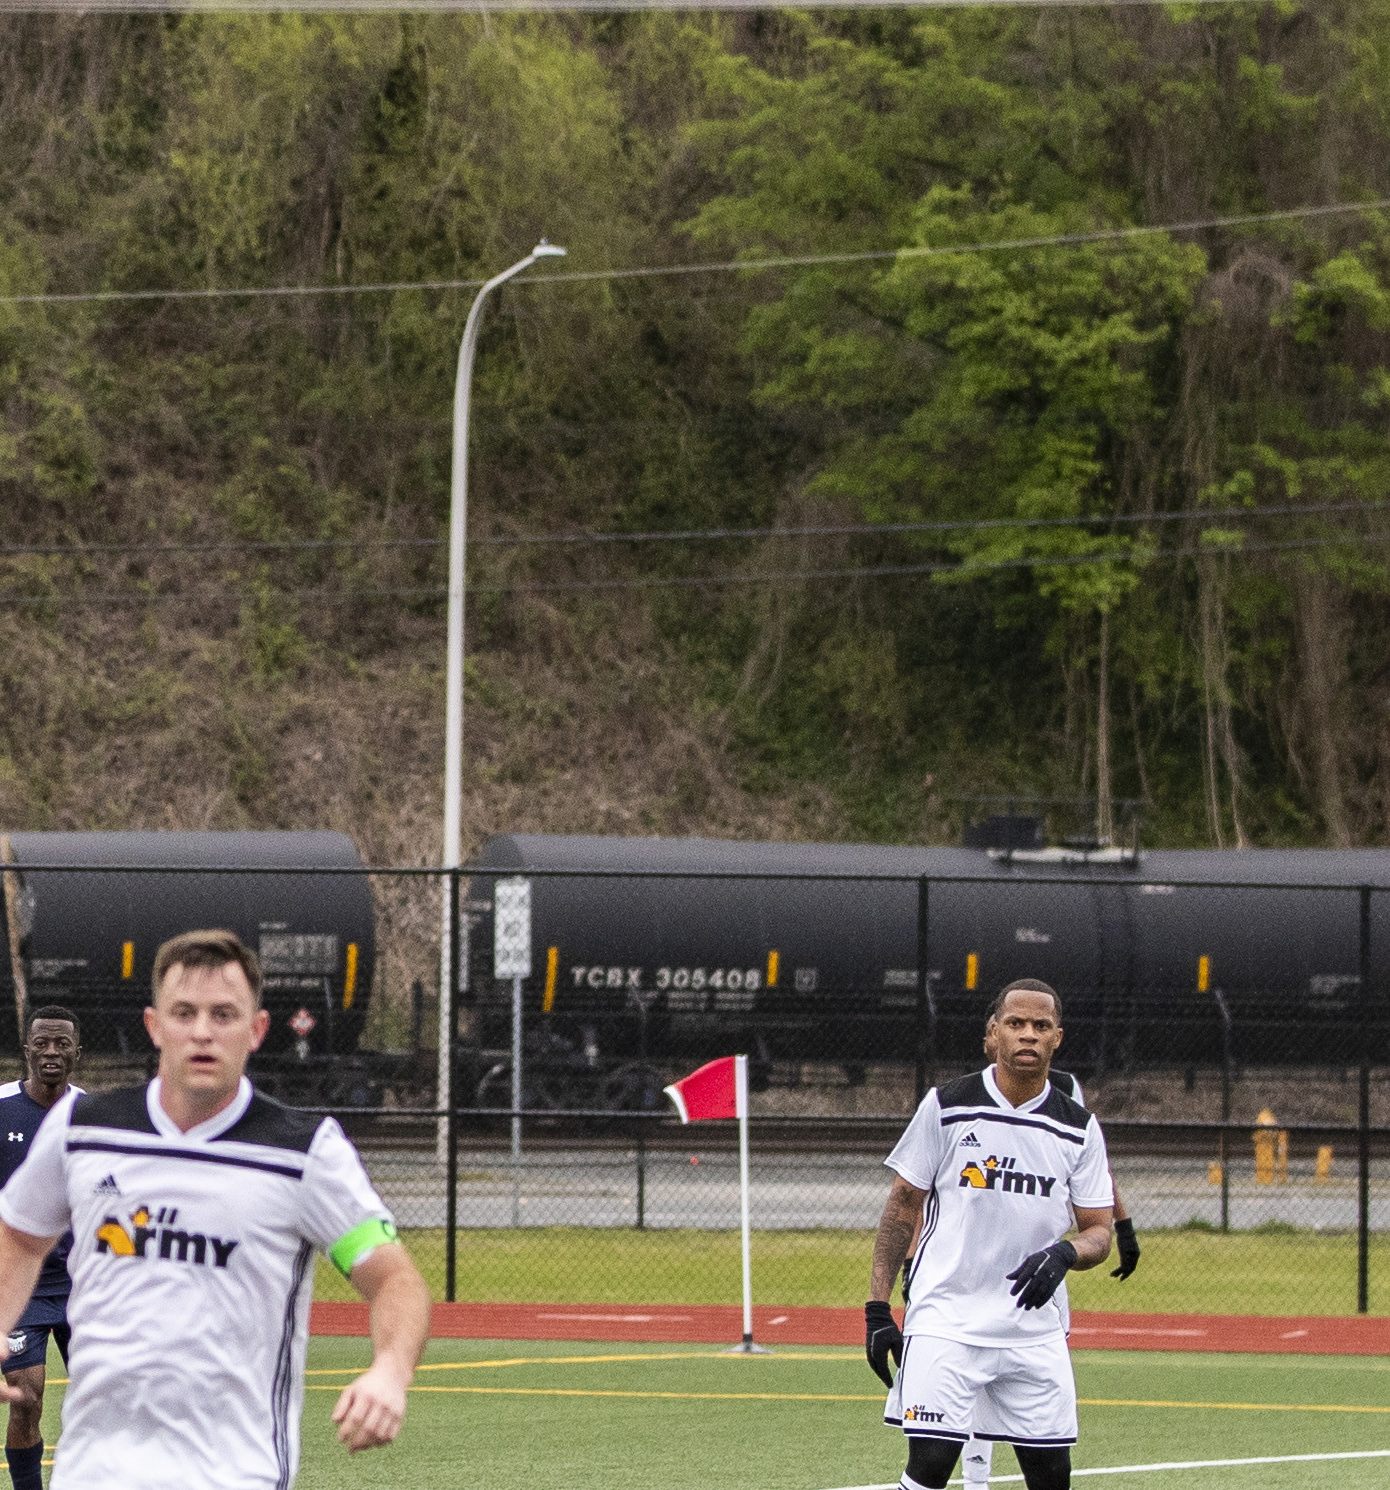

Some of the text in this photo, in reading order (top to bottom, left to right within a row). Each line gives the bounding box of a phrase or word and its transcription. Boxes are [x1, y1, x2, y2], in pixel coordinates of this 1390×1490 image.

[571, 966, 762, 990] TCBX 305408
[958, 1161, 1057, 1198] Army
[95, 1215, 239, 1268] Army
